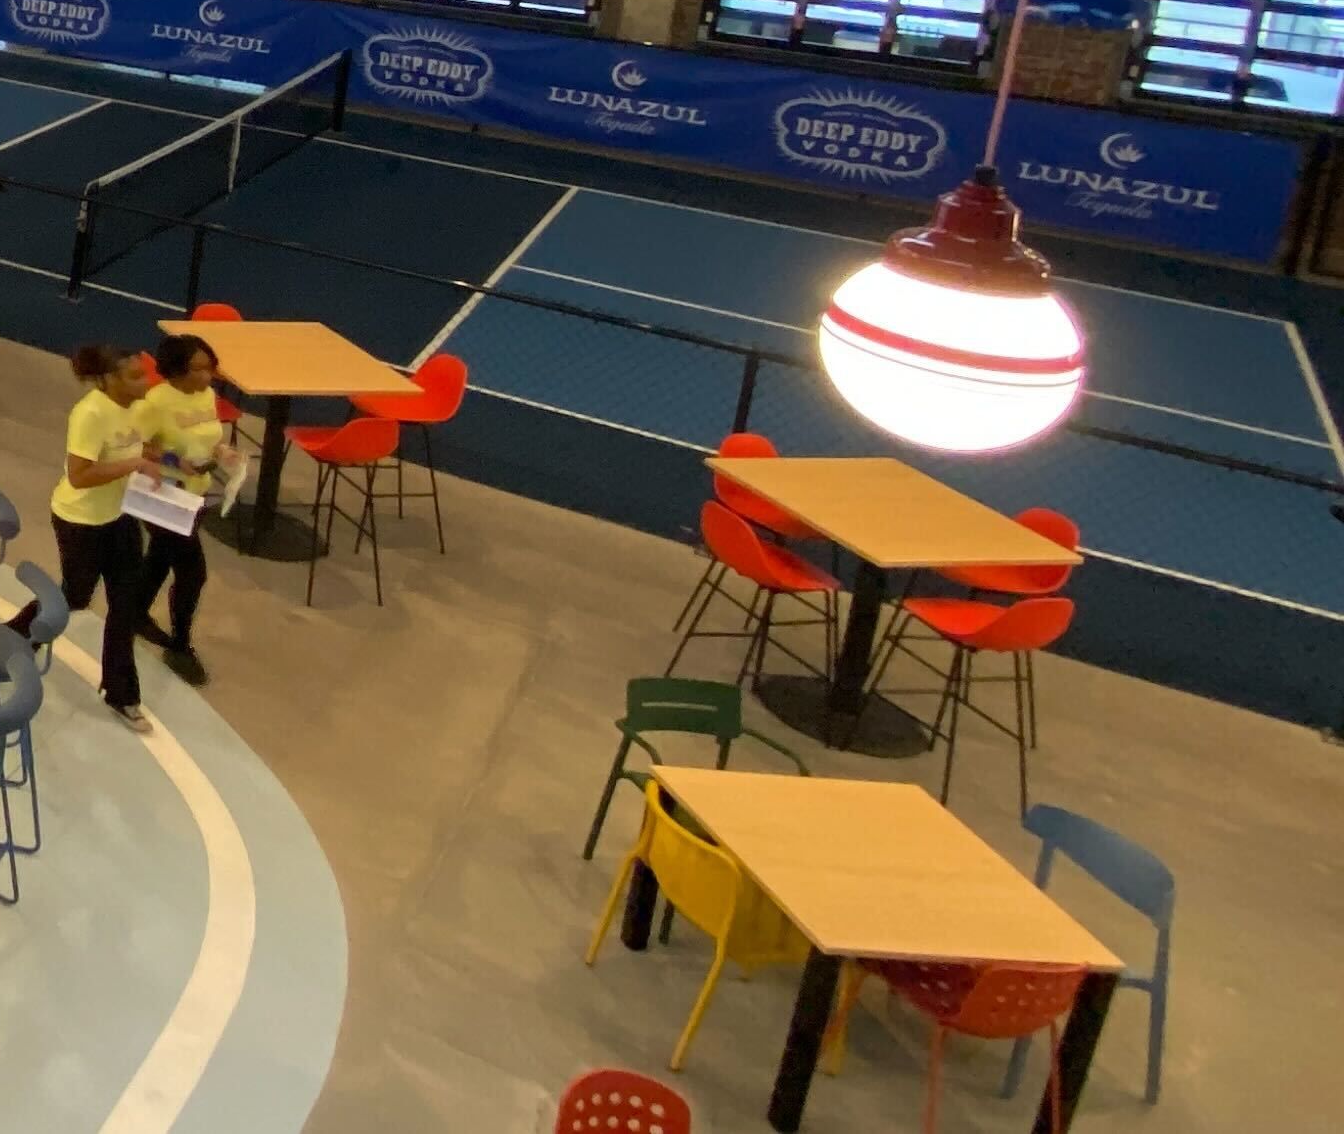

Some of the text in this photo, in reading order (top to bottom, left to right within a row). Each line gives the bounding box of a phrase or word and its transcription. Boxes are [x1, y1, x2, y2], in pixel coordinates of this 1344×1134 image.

[26, 13, 89, 33] VODKA
[59, 0, 97, 21] EDDY
[151, 23, 271, 54] LUNAZUL
[378, 50, 424, 72] DEEP
[426, 58, 480, 82] EDDY
[383, 69, 466, 92] VODKA
[547, 85, 708, 126] LUNAZUL
[795, 116, 856, 142] DEEP
[858, 127, 922, 154] EDDY
[801, 139, 910, 168] VODKA
[1017, 161, 1222, 211] LUNAZUL
